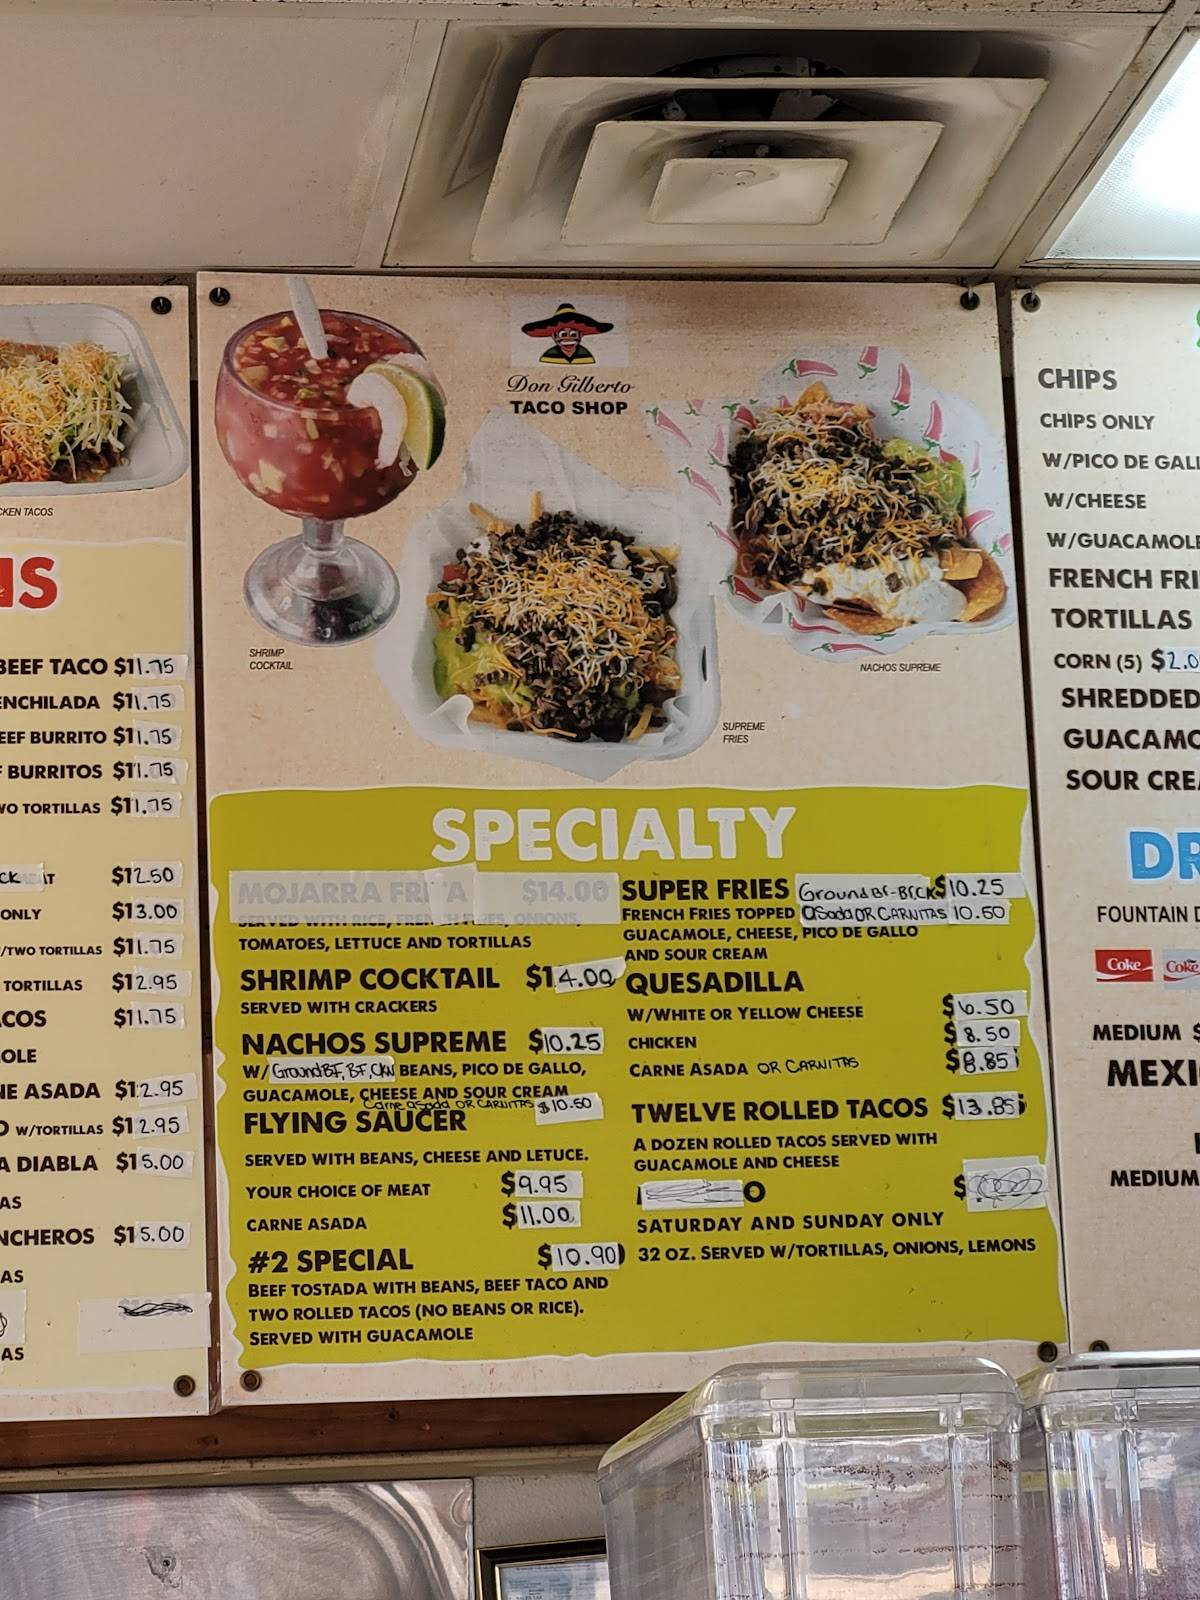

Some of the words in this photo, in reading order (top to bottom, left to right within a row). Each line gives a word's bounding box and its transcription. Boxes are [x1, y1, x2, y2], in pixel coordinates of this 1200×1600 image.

[506, 375, 554, 393] Don
[557, 375, 634, 393] Gilberto
[1038, 368, 1117, 390] CHIPS
[510, 401, 564, 414] TACO
[572, 401, 627, 414] SHOP
[1040, 413, 1097, 428] CHIPS
[1103, 415, 1155, 429] ONLY
[1042, 452, 1118, 469] W/PICO
[1124, 455, 1149, 469] DE
[1044, 493, 1146, 508] W/CHEESE
[24, 508, 54, 516] TACOS
[1050, 568, 1152, 588] FRENCH
[1051, 609, 1192, 629] TORTILLAS
[250, 649, 284, 657] SHRIMP
[50, 659, 108, 675] TACO
[114, 657, 174, 677] $11.75
[250, 661, 293, 669] COCKTAIL
[899, 663, 941, 671] SUPREME
[1054, 654, 1111, 669] CORN
[1116, 654, 1142, 673] (5)
[113, 691, 172, 711] $11.75
[1061, 688, 1200, 708] SHREDDED
[31, 731, 107, 744] BURRITO
[114, 726, 172, 746] $11.75
[722, 722, 765, 730] SUPREME
[723, 735, 749, 743] FRIES
[8, 765, 102, 779] BURRITOS
[113, 761, 173, 781] $11.75
[1066, 770, 1139, 790] SOUR
[23, 804, 100, 814] TORTILLAS
[111, 796, 172, 816] $11.75
[432, 808, 796, 861] SPECIALTY
[112, 866, 174, 886] $12.50
[622, 880, 709, 901] SUPER
[717, 878, 789, 899] FRIES
[1, 909, 42, 920] ONLY
[112, 901, 178, 921] $13.00
[623, 908, 684, 921] FRENCH
[690, 908, 730, 920] FRIES
[735, 908, 795, 919] TOPPED
[953, 905, 1006, 920] 10.50
[1097, 906, 1188, 922] FOUNTAIN
[239, 938, 329, 951] TOMATOES,
[335, 937, 401, 949] LETTUCE
[407, 937, 442, 948] AND
[448, 936, 532, 948] TORTILLAS
[624, 929, 732, 942] GUACAMOLE,
[737, 928, 798, 941] CHEESE,
[803, 927, 838, 938] PICO
[843, 926, 862, 937] DE
[867, 926, 918, 937] GALLO
[40, 946, 103, 955] TORTILLAS
[113, 937, 175, 957] $11.75
[625, 950, 659, 961] AND
[665, 949, 707, 960] SOUR
[712, 948, 768, 959] CREAM
[1107, 958, 1141, 970] Coke
[1166, 961, 1199, 973] Coke
[4, 980, 83, 991] TORTILLAS
[112, 972, 178, 992] $12.95
[240, 969, 351, 991] SHRIMP
[360, 968, 500, 990] COCKTAIL
[626, 971, 805, 996] QUESADILLA
[241, 1002, 301, 1014] SERVED
[308, 1001, 349, 1013] WITH
[355, 1000, 437, 1013] CRACKERS
[710, 1008, 733, 1020] OR
[738, 1007, 801, 1019] YELLOW
[807, 1006, 863, 1018] CHEESE
[114, 1008, 176, 1028] $11.75
[1093, 1025, 1181, 1040] MEDIUM
[242, 1033, 366, 1055] NACHOS
[375, 1031, 506, 1054] SUPREME
[628, 1037, 697, 1049] CHICKEN
[400, 1064, 457, 1078] BEANS,
[463, 1064, 498, 1075] PICO
[503, 1063, 524, 1074] DE
[529, 1062, 586, 1076] GALLO,
[630, 1064, 684, 1077] CARNE
[690, 1063, 749, 1076] ASADA
[24, 1083, 100, 1099] ASADA
[115, 1080, 183, 1100] $12.95
[243, 1088, 355, 1103] GUACAMOLE,
[360, 1088, 417, 1100] CHEESE
[423, 1087, 458, 1099] AND
[463, 1086, 506, 1098] SOUR
[512, 1085, 568, 1097] CREAM
[632, 1102, 737, 1123] TWELVE
[743, 1100, 839, 1121] ROLLED
[847, 1098, 928, 1119] TACOS
[16, 1125, 103, 1136] W/TORTILLAS
[112, 1116, 180, 1134] $12.95
[244, 1111, 347, 1134] FLYING
[356, 1109, 467, 1132] SAUCER
[634, 1138, 646, 1151] A
[651, 1138, 708, 1150] DOZEN
[713, 1137, 771, 1149] ROLLED
[776, 1135, 826, 1148] TACOS
[832, 1134, 891, 1146] SERVED
[896, 1133, 937, 1145] WITH
[17, 1156, 98, 1172] DIABLA
[116, 1153, 183, 1173] $15.00
[245, 1154, 306, 1167] SERVED
[312, 1153, 354, 1165] WITH
[360, 1152, 418, 1166] BEANS,
[423, 1151, 480, 1163] CHEESE
[486, 1150, 521, 1162] AND
[526, 1149, 588, 1161] LETUCE.
[634, 1158, 737, 1171] GUACAMOLE
[743, 1157, 777, 1169] AND
[783, 1155, 839, 1168] CHEESE
[246, 1186, 292, 1199] YOUR
[297, 1185, 357, 1198] CHOICE
[361, 1185, 382, 1196] OF
[387, 1184, 431, 1196] MEAT
[501, 1171, 568, 1197] $9.95
[1110, 1170, 1200, 1187] MEDIUM
[247, 1219, 302, 1231] CARNE
[308, 1217, 367, 1230] ASADA
[638, 1217, 742, 1232] SATURDAY
[751, 1216, 795, 1230] AND
[803, 1213, 883, 1228] SUNDAY
[892, 1212, 944, 1226] ONLY
[114, 1225, 184, 1245] $15.00
[639, 1248, 660, 1261] 32
[665, 1248, 696, 1260] OZ.
[701, 1246, 764, 1259] SERVED
[770, 1243, 888, 1257] W/TORTILLAS,
[893, 1241, 963, 1255] ONIONS,
[969, 1239, 1035, 1252] LEMONS
[248, 1251, 288, 1273] #2
[297, 1248, 413, 1272] SPECIAL
[249, 1283, 286, 1297] BEEF
[292, 1282, 368, 1296] TOSTADA
[373, 1281, 416, 1294] WITH
[421, 1280, 479, 1294] BEANS,
[485, 1279, 520, 1291] BEEF
[526, 1278, 568, 1290] TACO
[573, 1277, 608, 1289] AND
[249, 1309, 288, 1321] TWO
[293, 1307, 354, 1320] ROLLED
[359, 1305, 411, 1319] TACOS
[415, 1303, 447, 1320] (NO
[453, 1304, 506, 1316] BEANS
[511, 1303, 533, 1314] OR
[539, 1300, 584, 1316] RICE).
[250, 1332, 313, 1345] SERVED
[319, 1331, 361, 1344] WITH
[367, 1328, 473, 1342] GUACAMOLE
